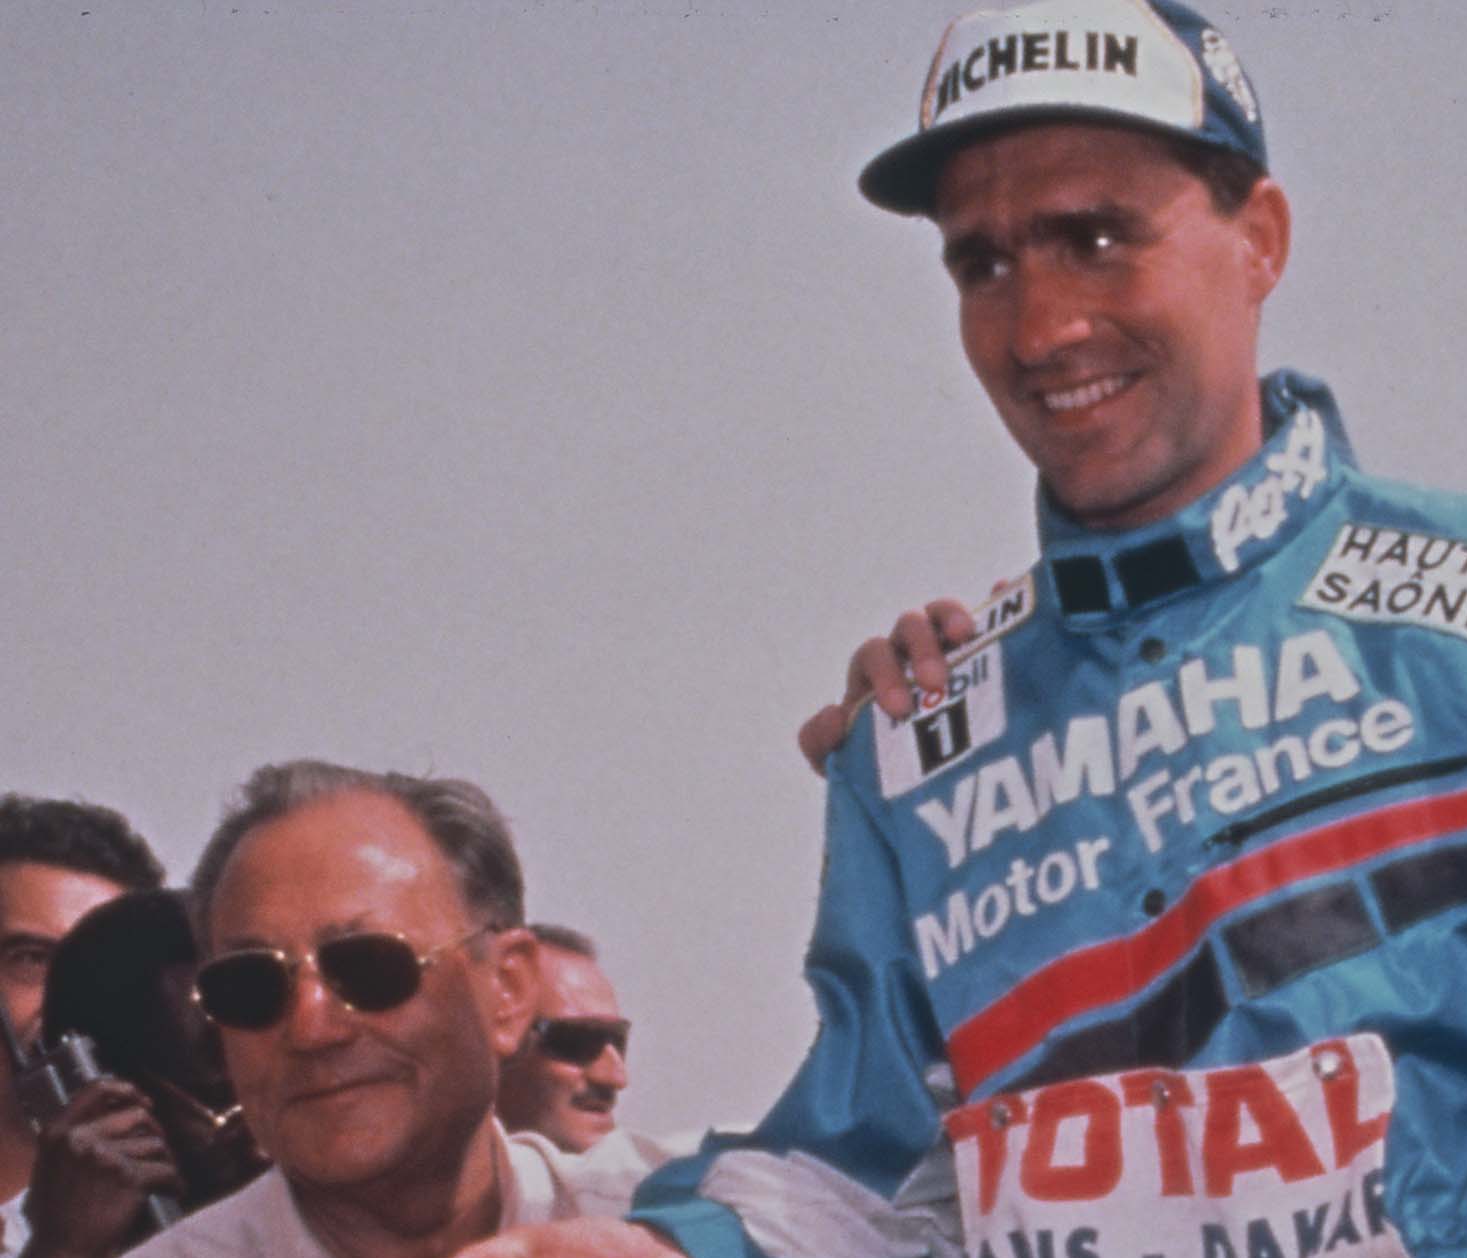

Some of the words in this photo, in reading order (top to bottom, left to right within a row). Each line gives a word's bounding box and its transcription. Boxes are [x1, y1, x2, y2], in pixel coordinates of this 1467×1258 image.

[888, 654, 990, 728] obil
[916, 630, 1361, 869] YAMAHA
[914, 834, 1112, 980] Motor
[1127, 698, 1415, 853] France
[942, 1038, 1391, 1217] TOTAL
